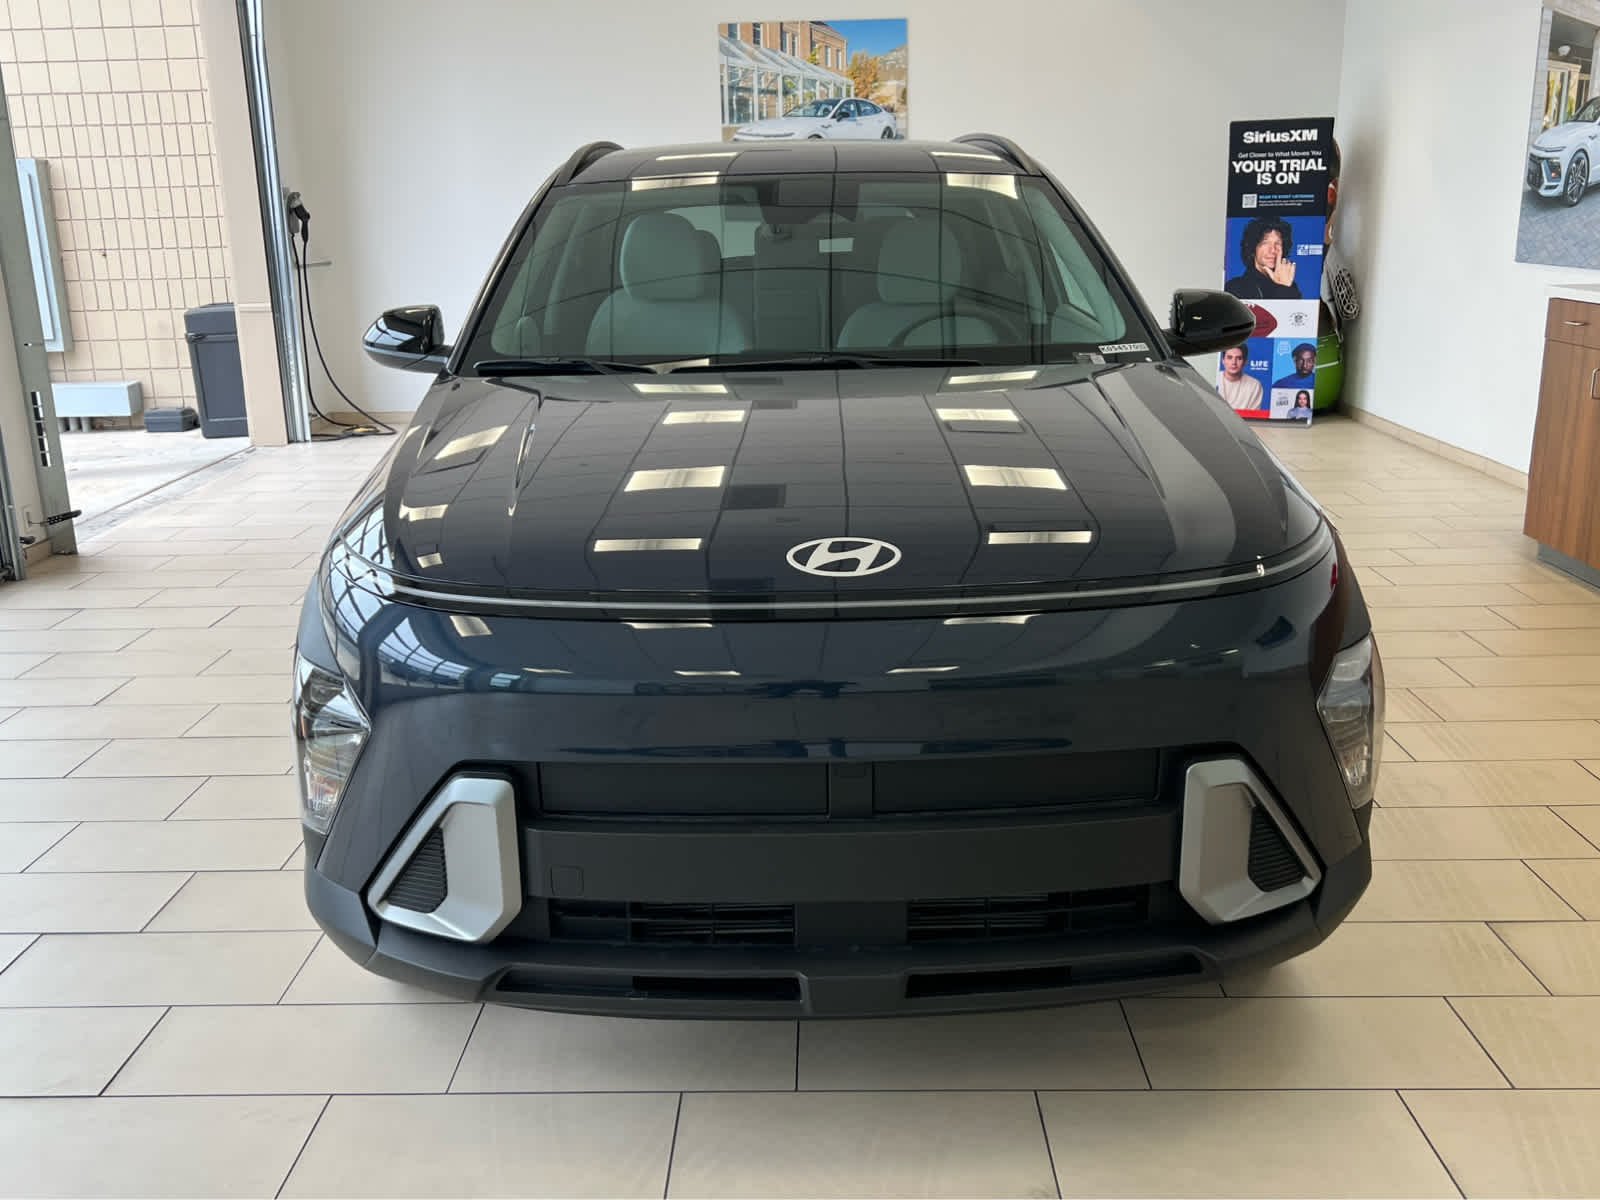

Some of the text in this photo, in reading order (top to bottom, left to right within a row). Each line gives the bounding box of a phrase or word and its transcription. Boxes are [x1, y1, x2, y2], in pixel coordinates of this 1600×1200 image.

[1243, 128, 1318, 143] SiriusXM
[1232, 158, 1327, 173] YOUR TRIAL
[1256, 172, 1300, 185] IS ON
[1250, 360, 1269, 368] LIFE
